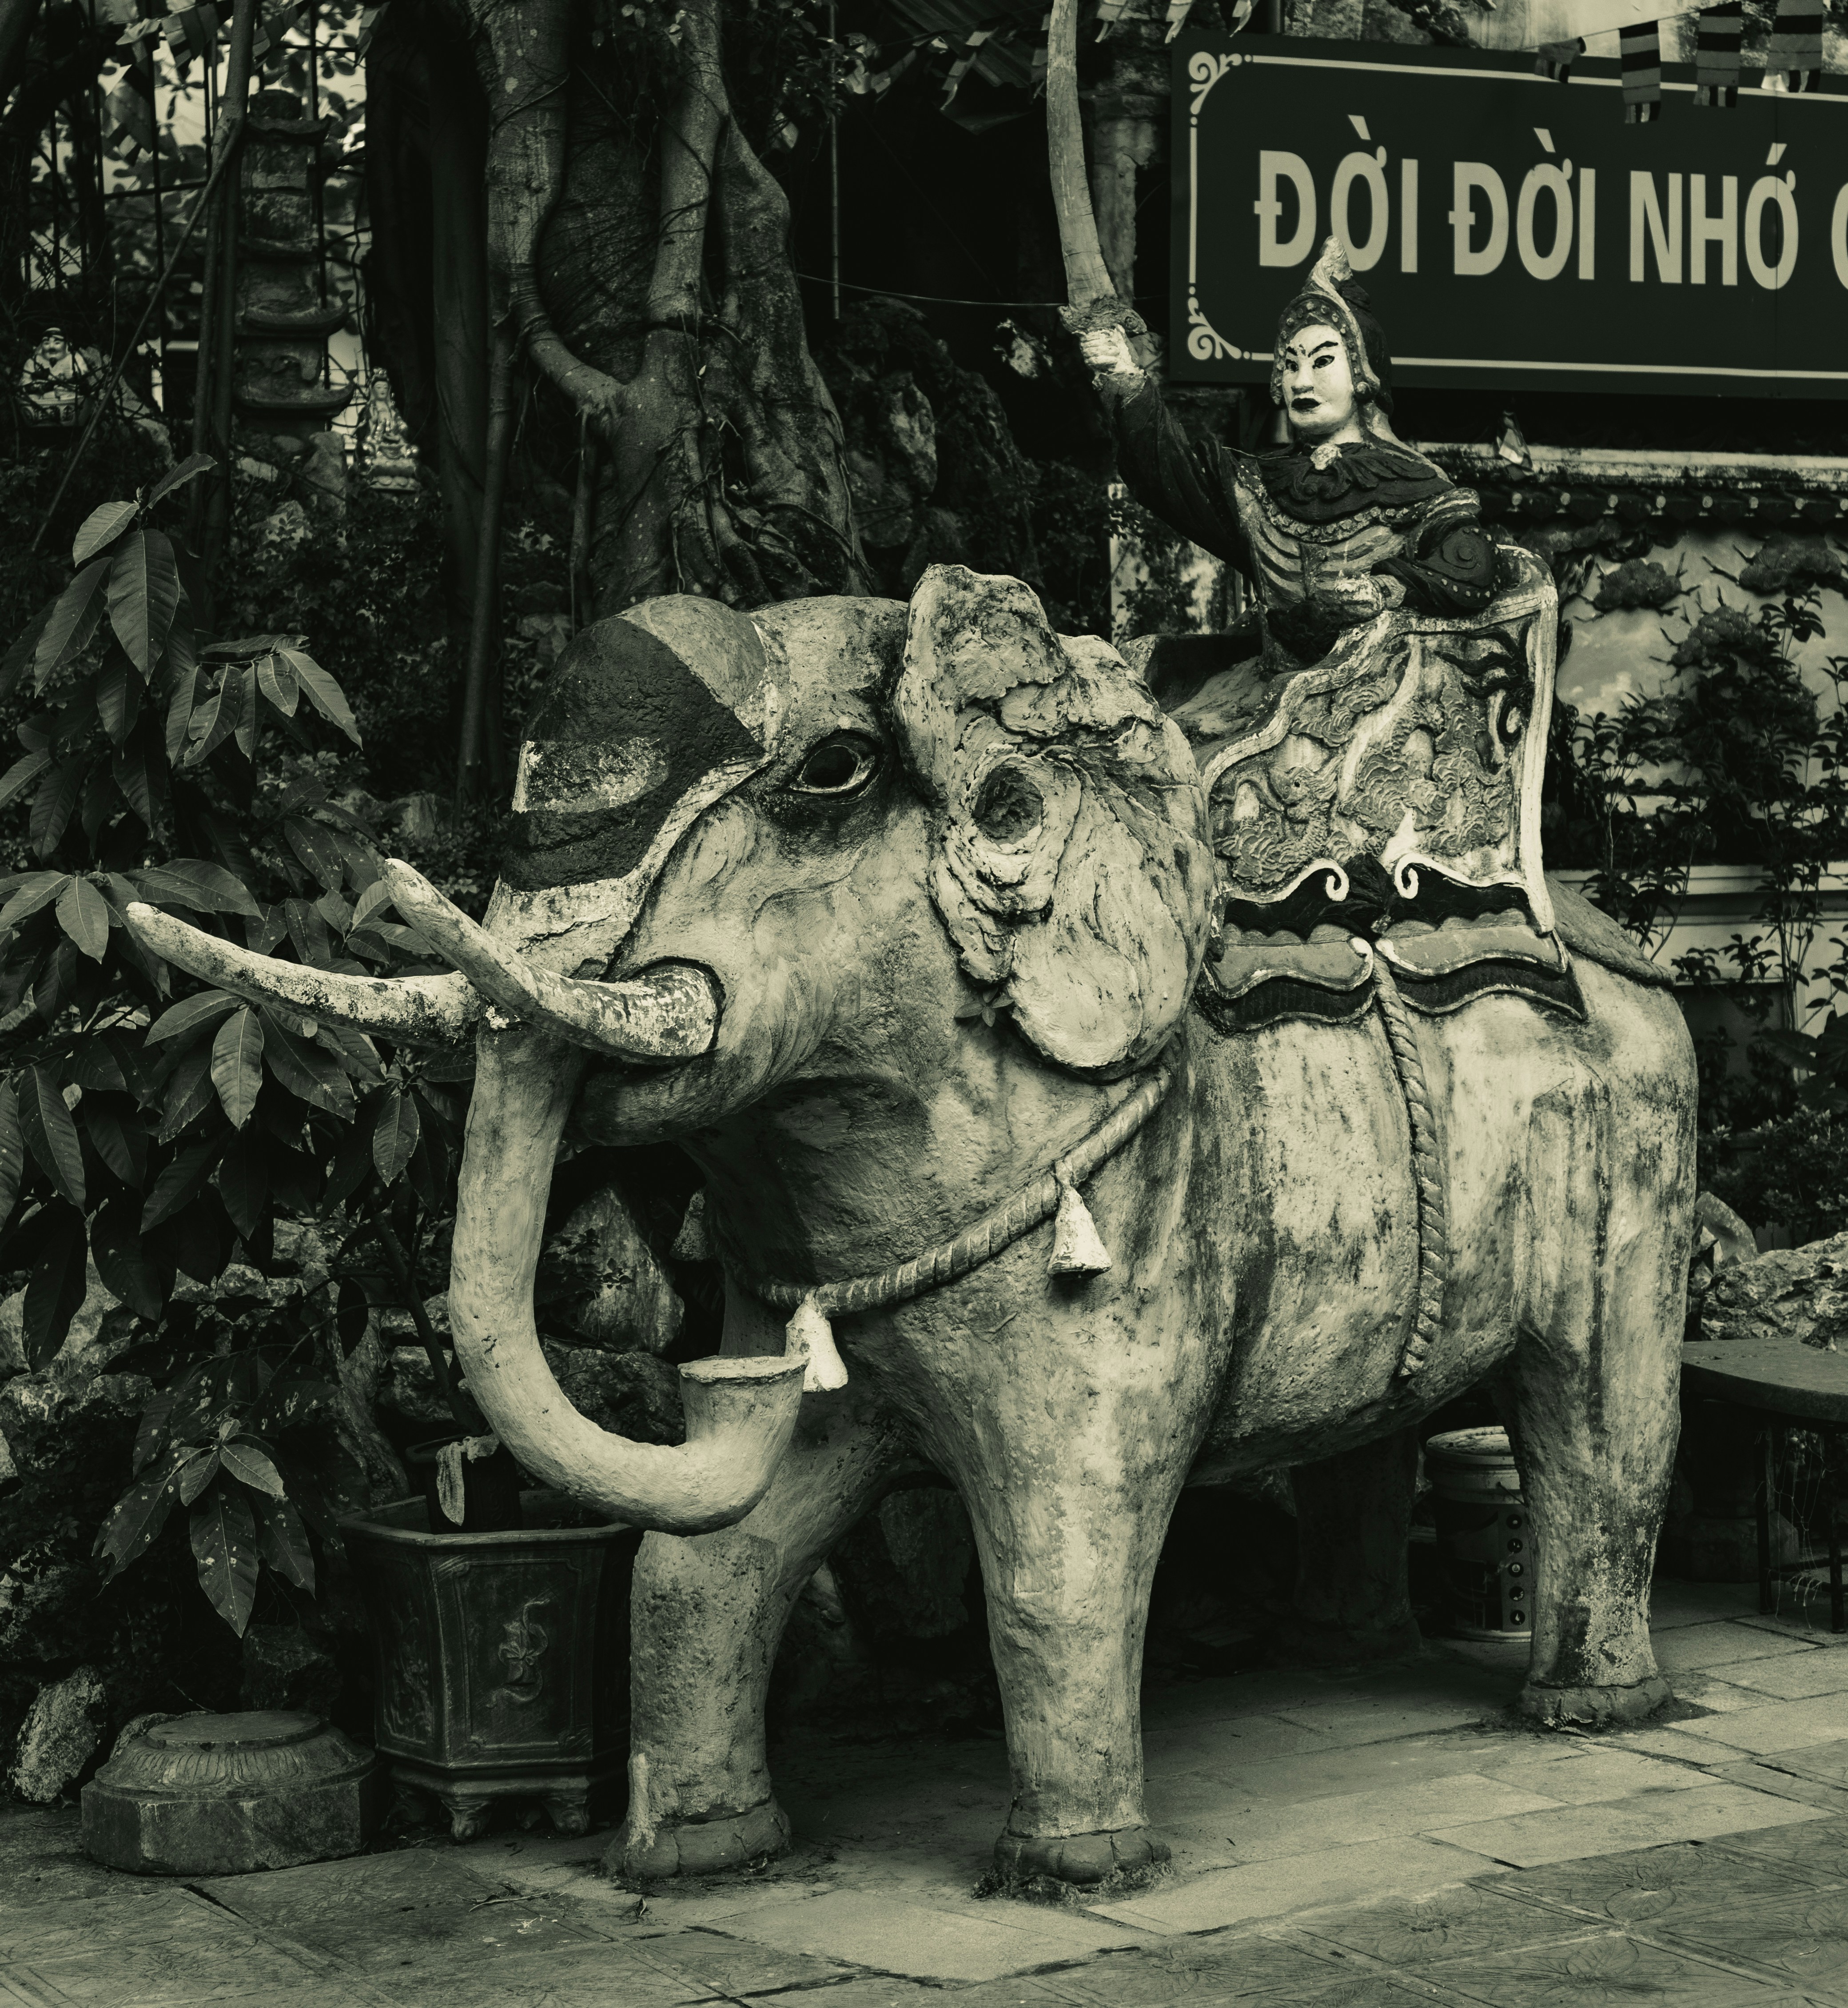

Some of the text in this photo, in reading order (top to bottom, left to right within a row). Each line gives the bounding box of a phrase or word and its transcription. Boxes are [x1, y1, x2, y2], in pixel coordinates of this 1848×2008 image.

[1254, 115, 1418, 272] ĐỜI
[1449, 128, 1596, 280] ĐỜI
[1630, 143, 1799, 290] NHỚ
